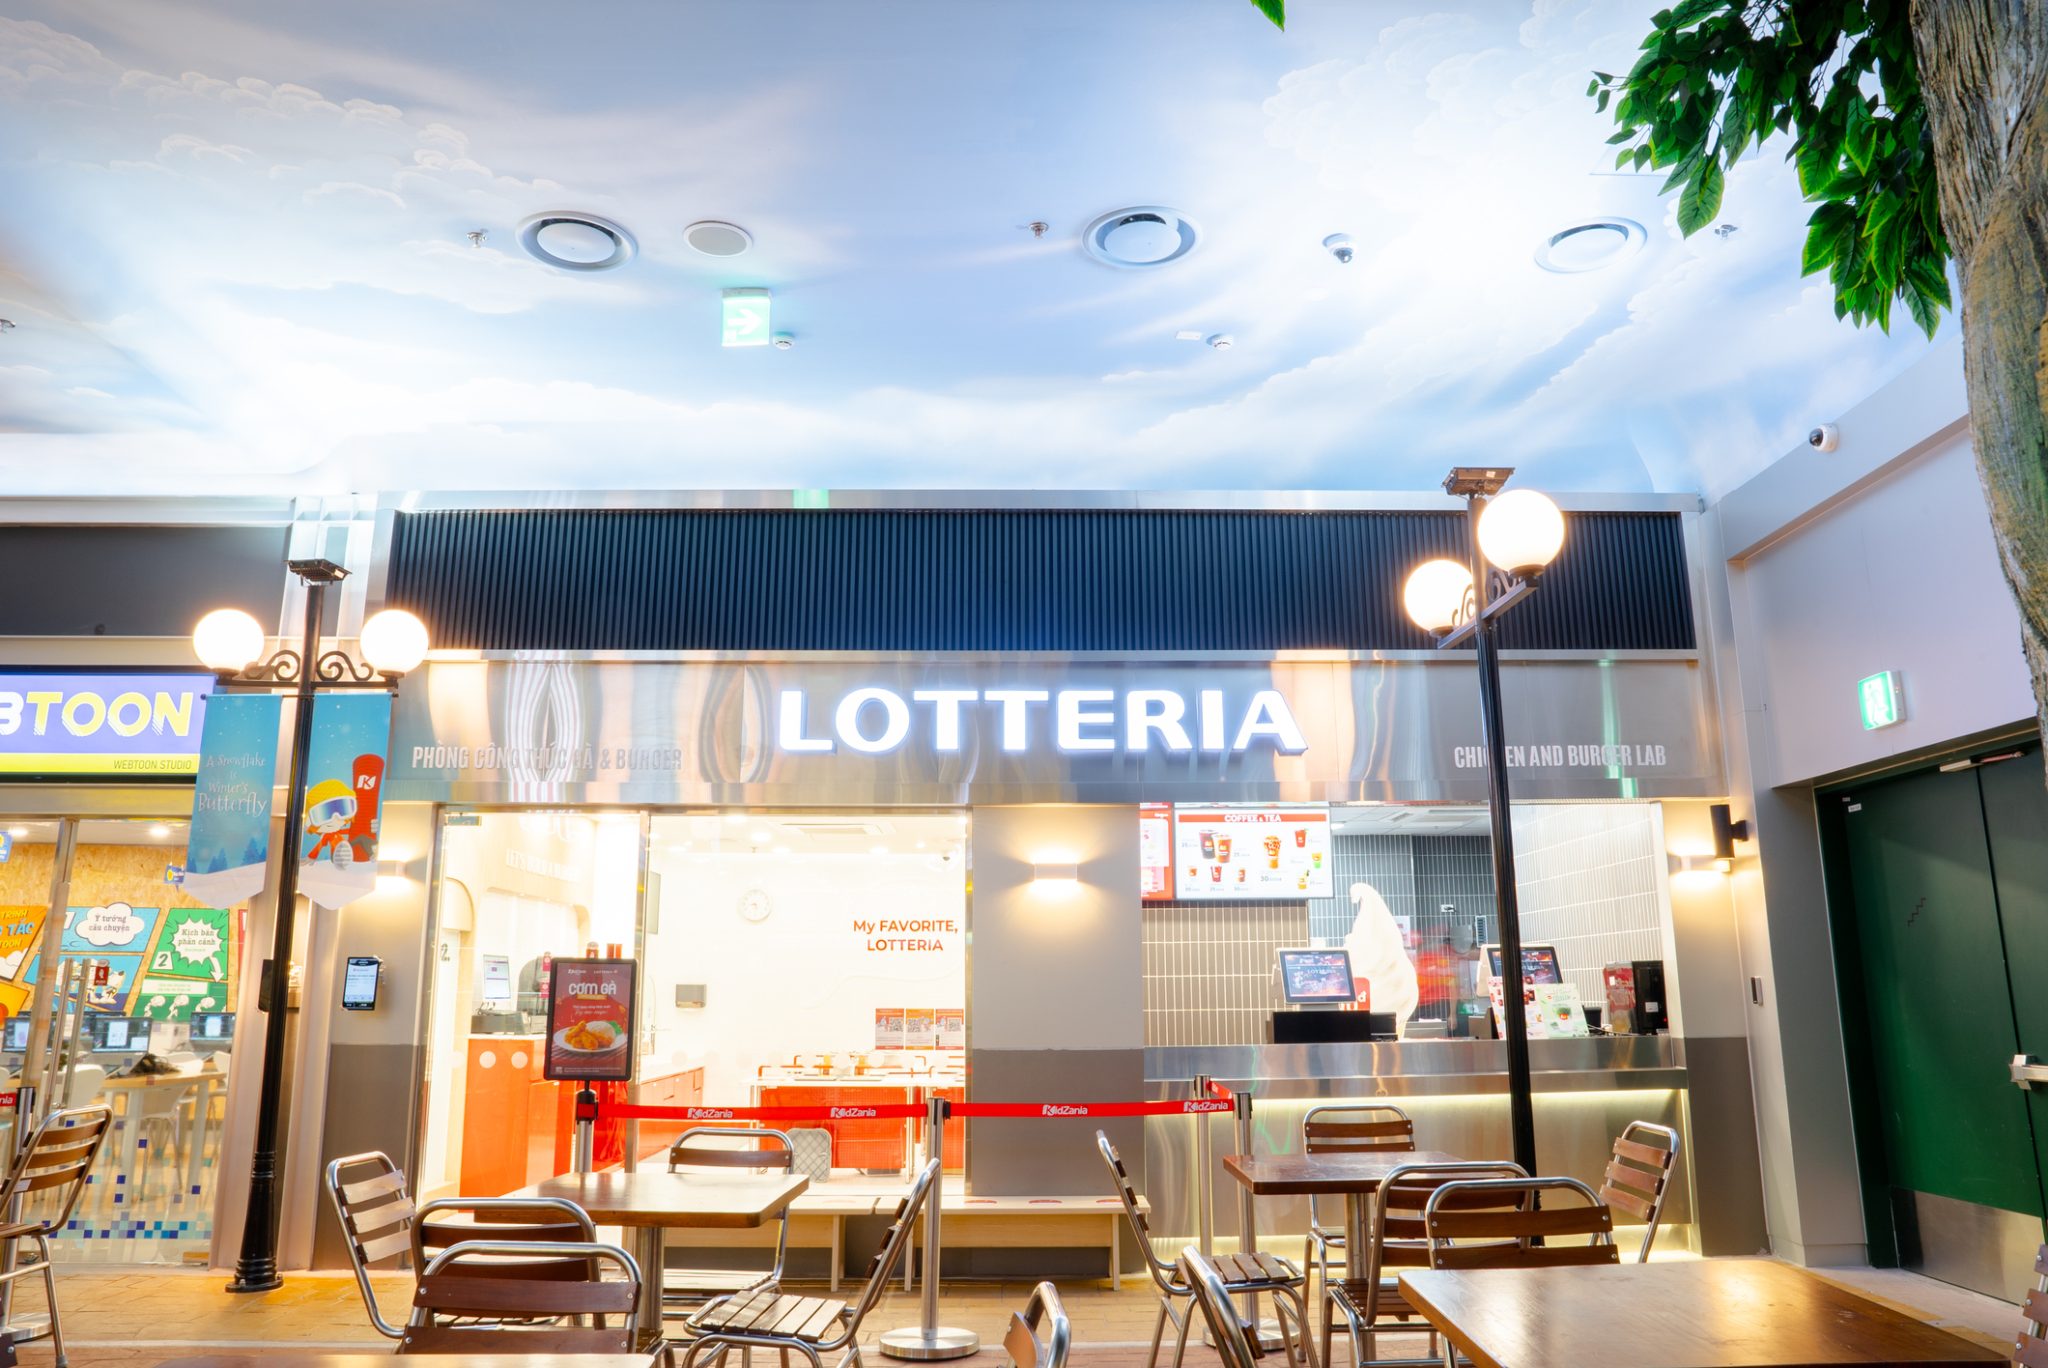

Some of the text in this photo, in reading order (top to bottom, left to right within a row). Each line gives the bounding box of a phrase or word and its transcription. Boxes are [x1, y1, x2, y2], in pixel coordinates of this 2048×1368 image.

[778, 688, 1307, 755] LOTTERIA
[411, 740, 470, 769] PHÒNG
[600, 748, 610, 769] &
[615, 747, 682, 770] BURGER
[1530, 745, 1563, 767] AND
[1568, 744, 1632, 766] BURGER
[1636, 744, 1667, 766] LAB
[113, 759, 192, 770] WEBTOON STUDIO
[198, 792, 268, 817] Butterfly
[1224, 813, 1258, 823] COFFEE
[1263, 813, 1282, 823] TEA
[853, 920, 958, 934] My FAVORITE,
[867, 939, 944, 951] LOTTERIA
[158, 953, 169, 967] 2
[688, 1107, 876, 1119] KidZania KidZania
[1042, 1100, 1229, 1116] KidZania KidZania
